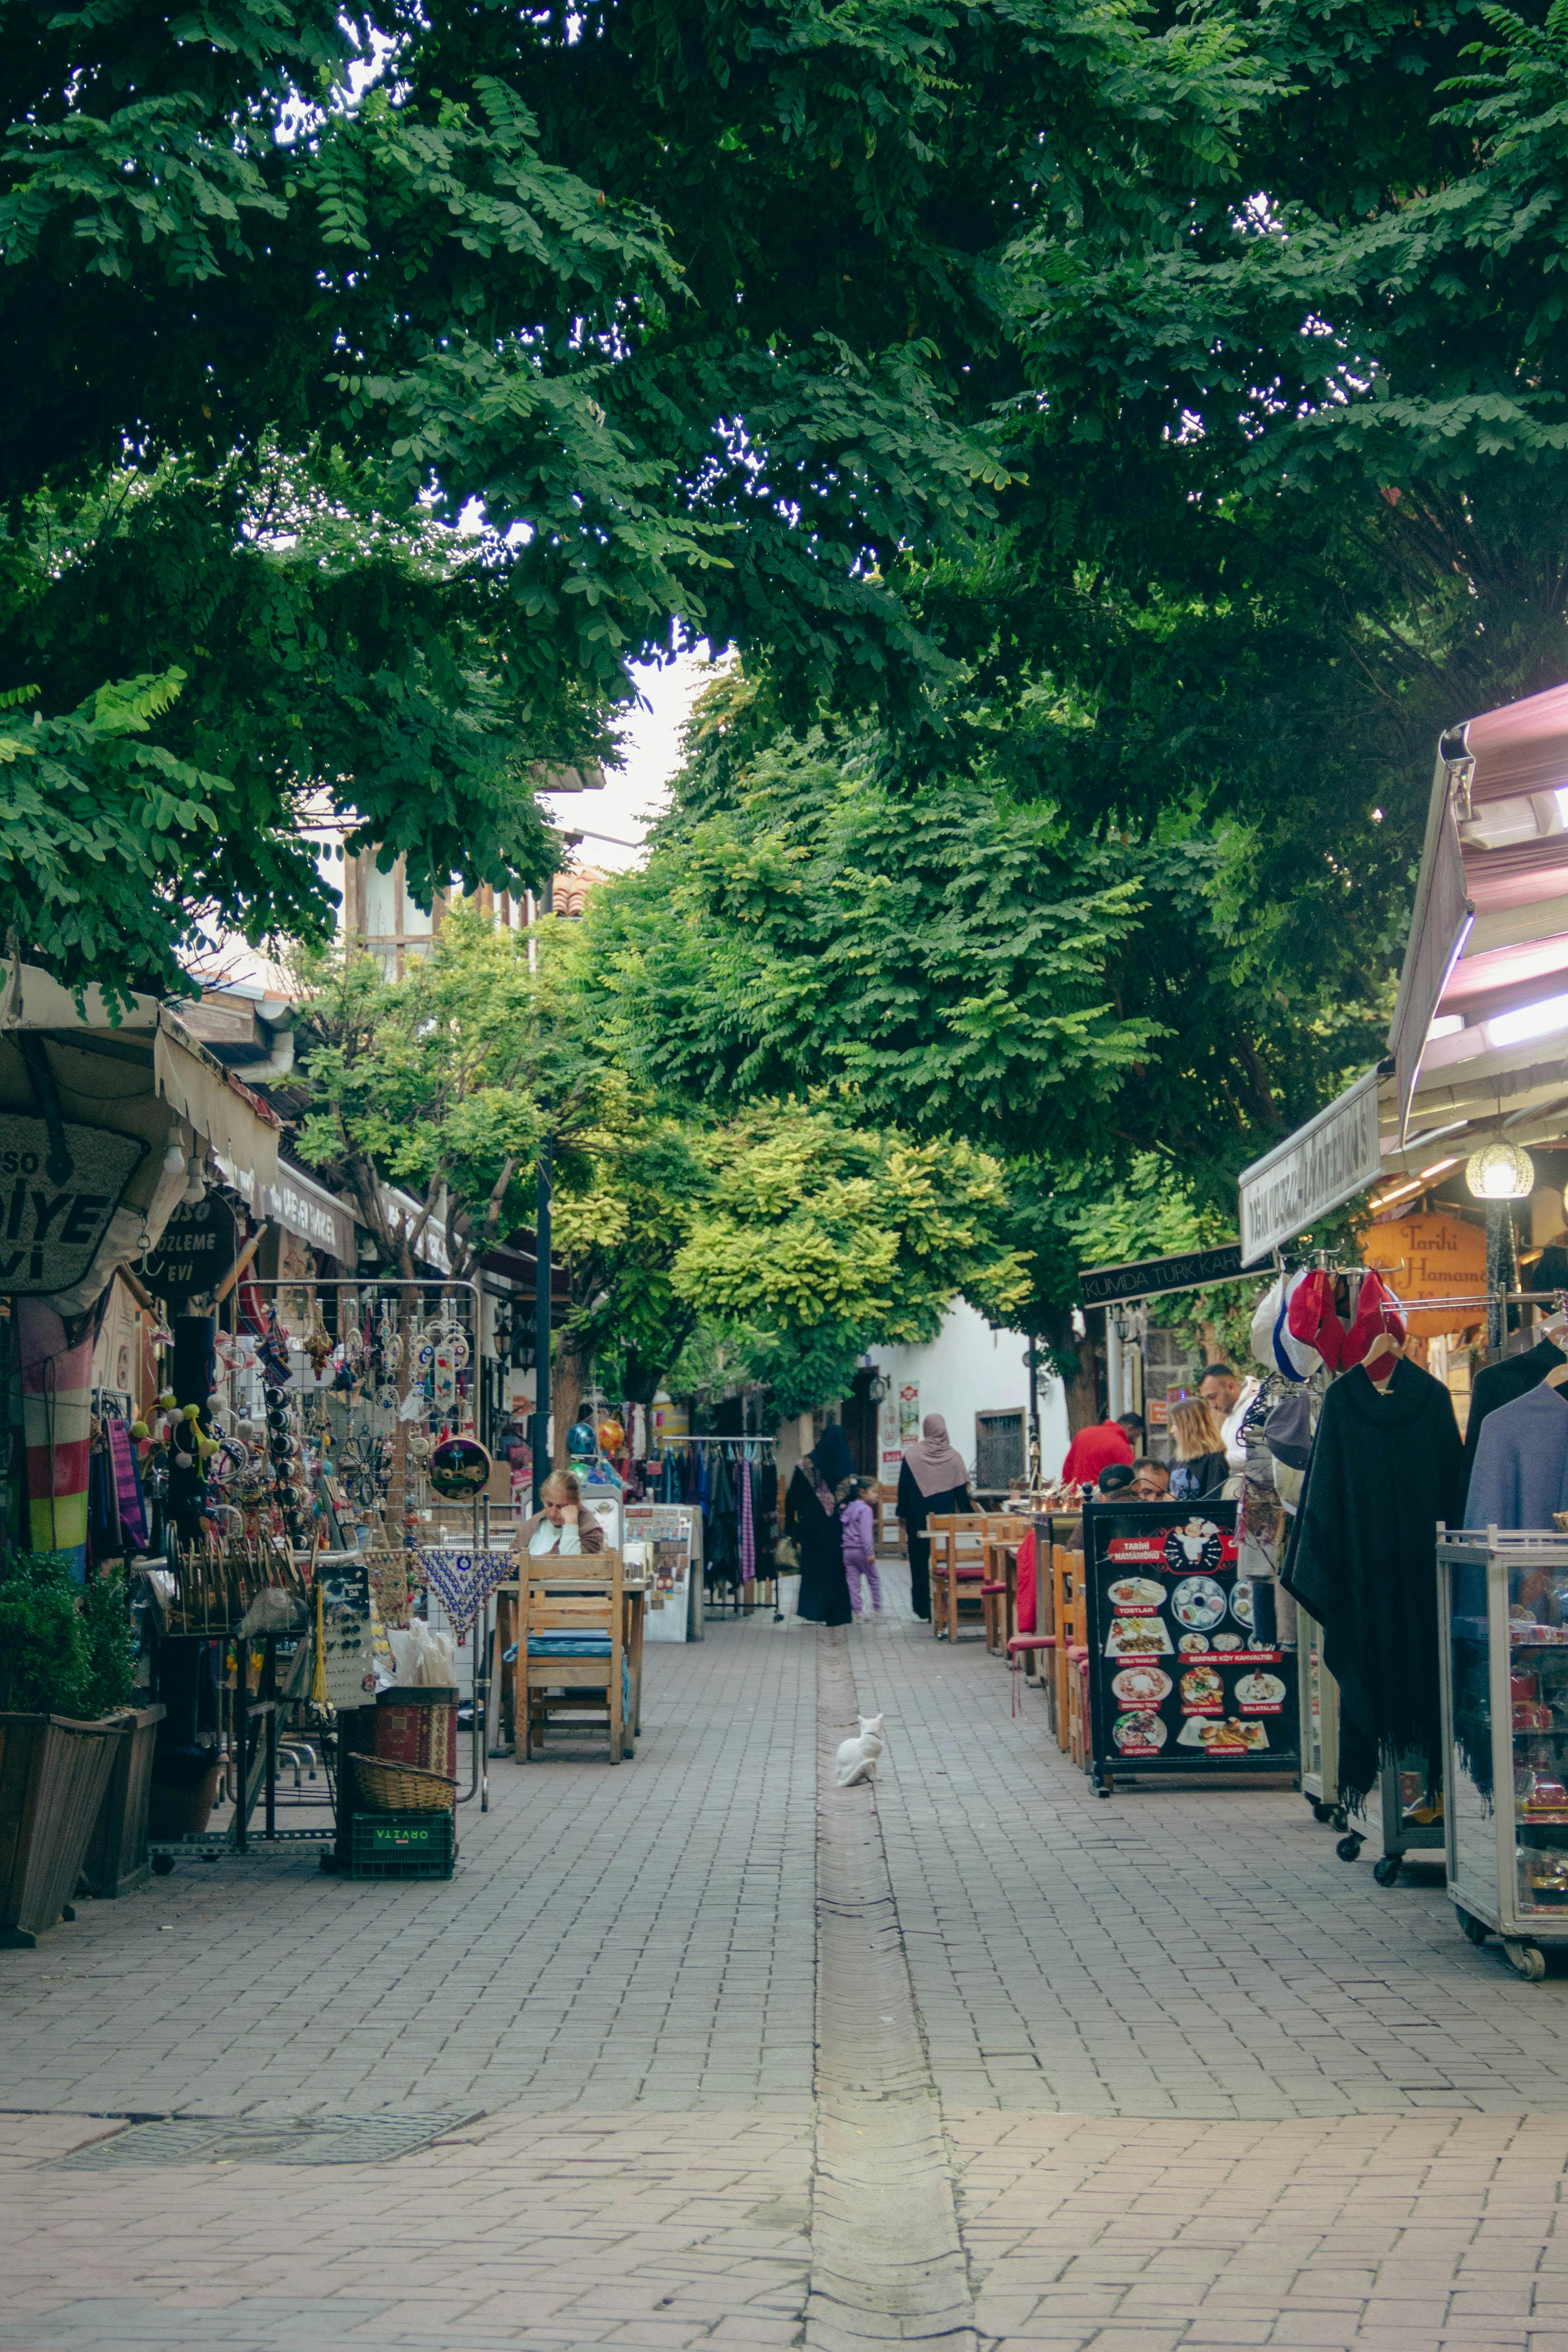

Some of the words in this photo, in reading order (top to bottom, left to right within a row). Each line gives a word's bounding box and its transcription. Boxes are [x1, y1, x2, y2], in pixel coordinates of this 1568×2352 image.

[1401, 1225, 1458, 1250] Tarihi
[167, 1260, 194, 1282] EVİ
[1083, 1271, 1149, 1298] KUMDA
[1153, 1259, 1197, 1284] TÜRK
[1124, 1541, 1150, 1550] TARİHİ
